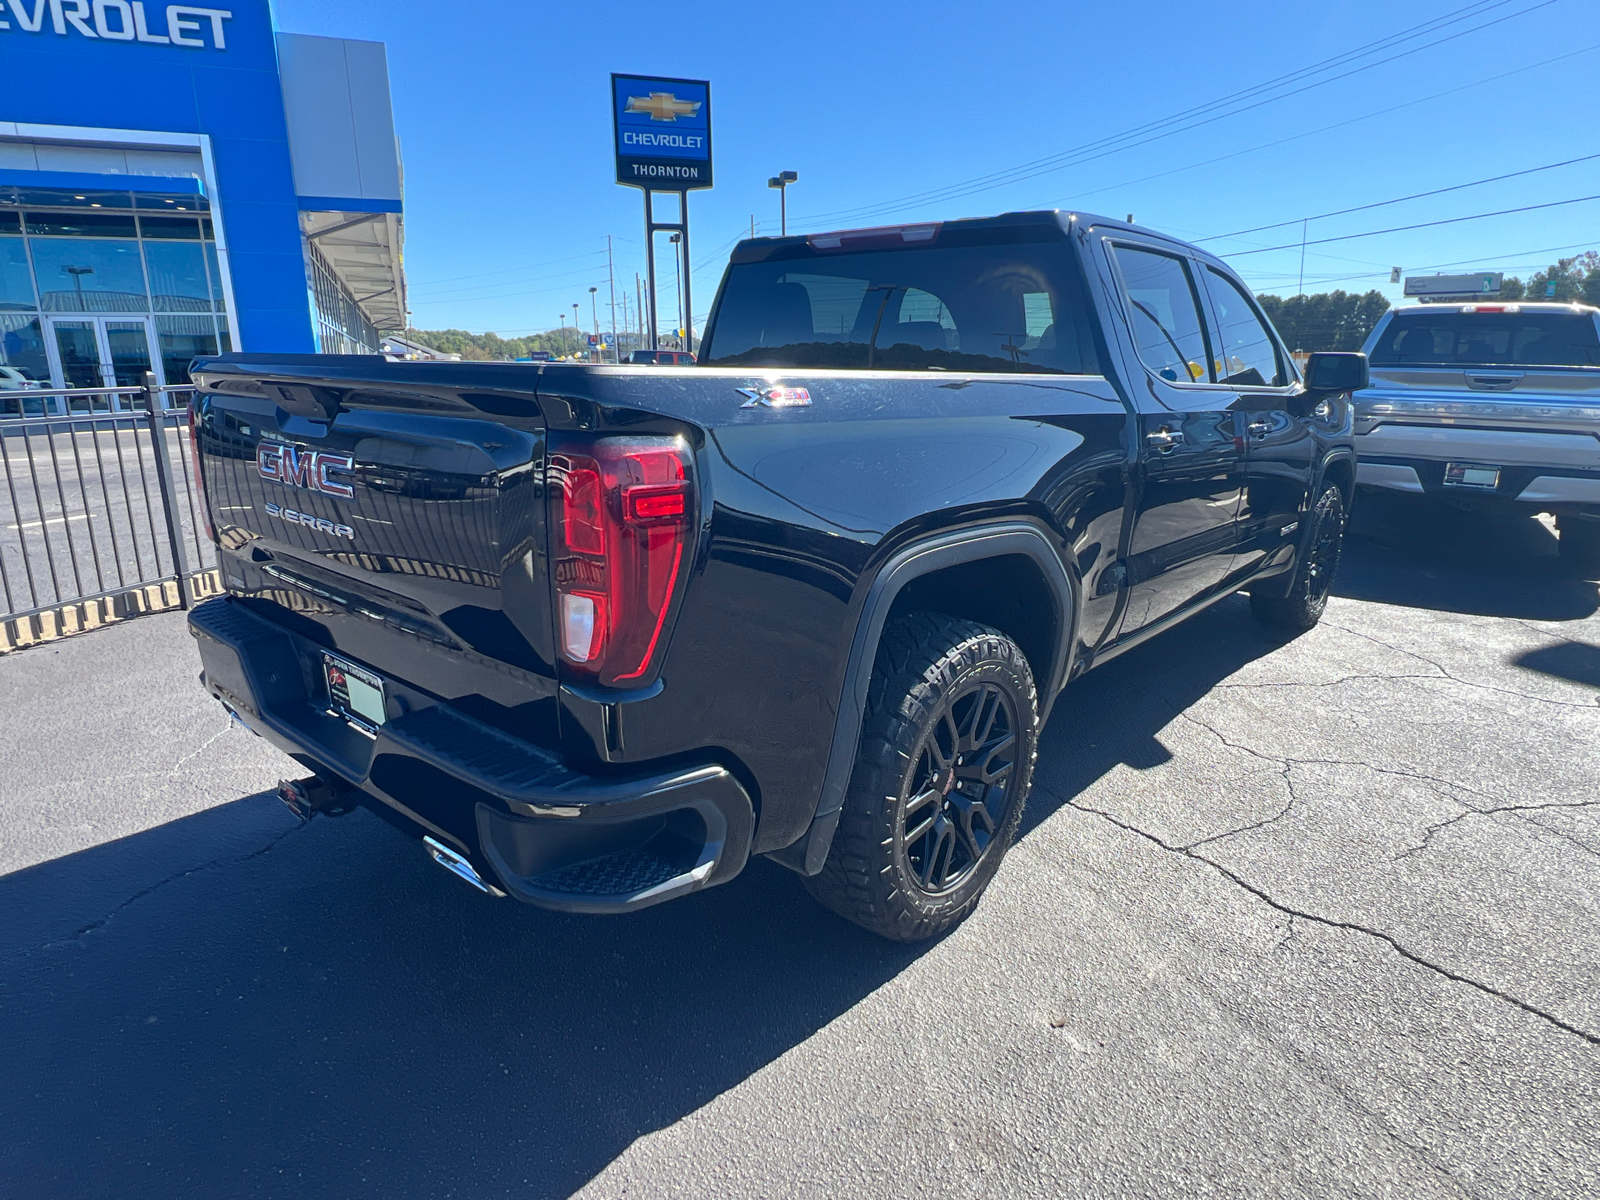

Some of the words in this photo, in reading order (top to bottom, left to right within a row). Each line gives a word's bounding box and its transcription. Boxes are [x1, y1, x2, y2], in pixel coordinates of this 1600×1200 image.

[0, 0, 232, 49] VROLET
[624, 132, 703, 148] CHEVROLET
[632, 164, 698, 178] THORNTON
[1400, 402, 1581, 416] PLATINUM
[256, 442, 355, 499] GMC
[265, 502, 355, 540] SIERRA
